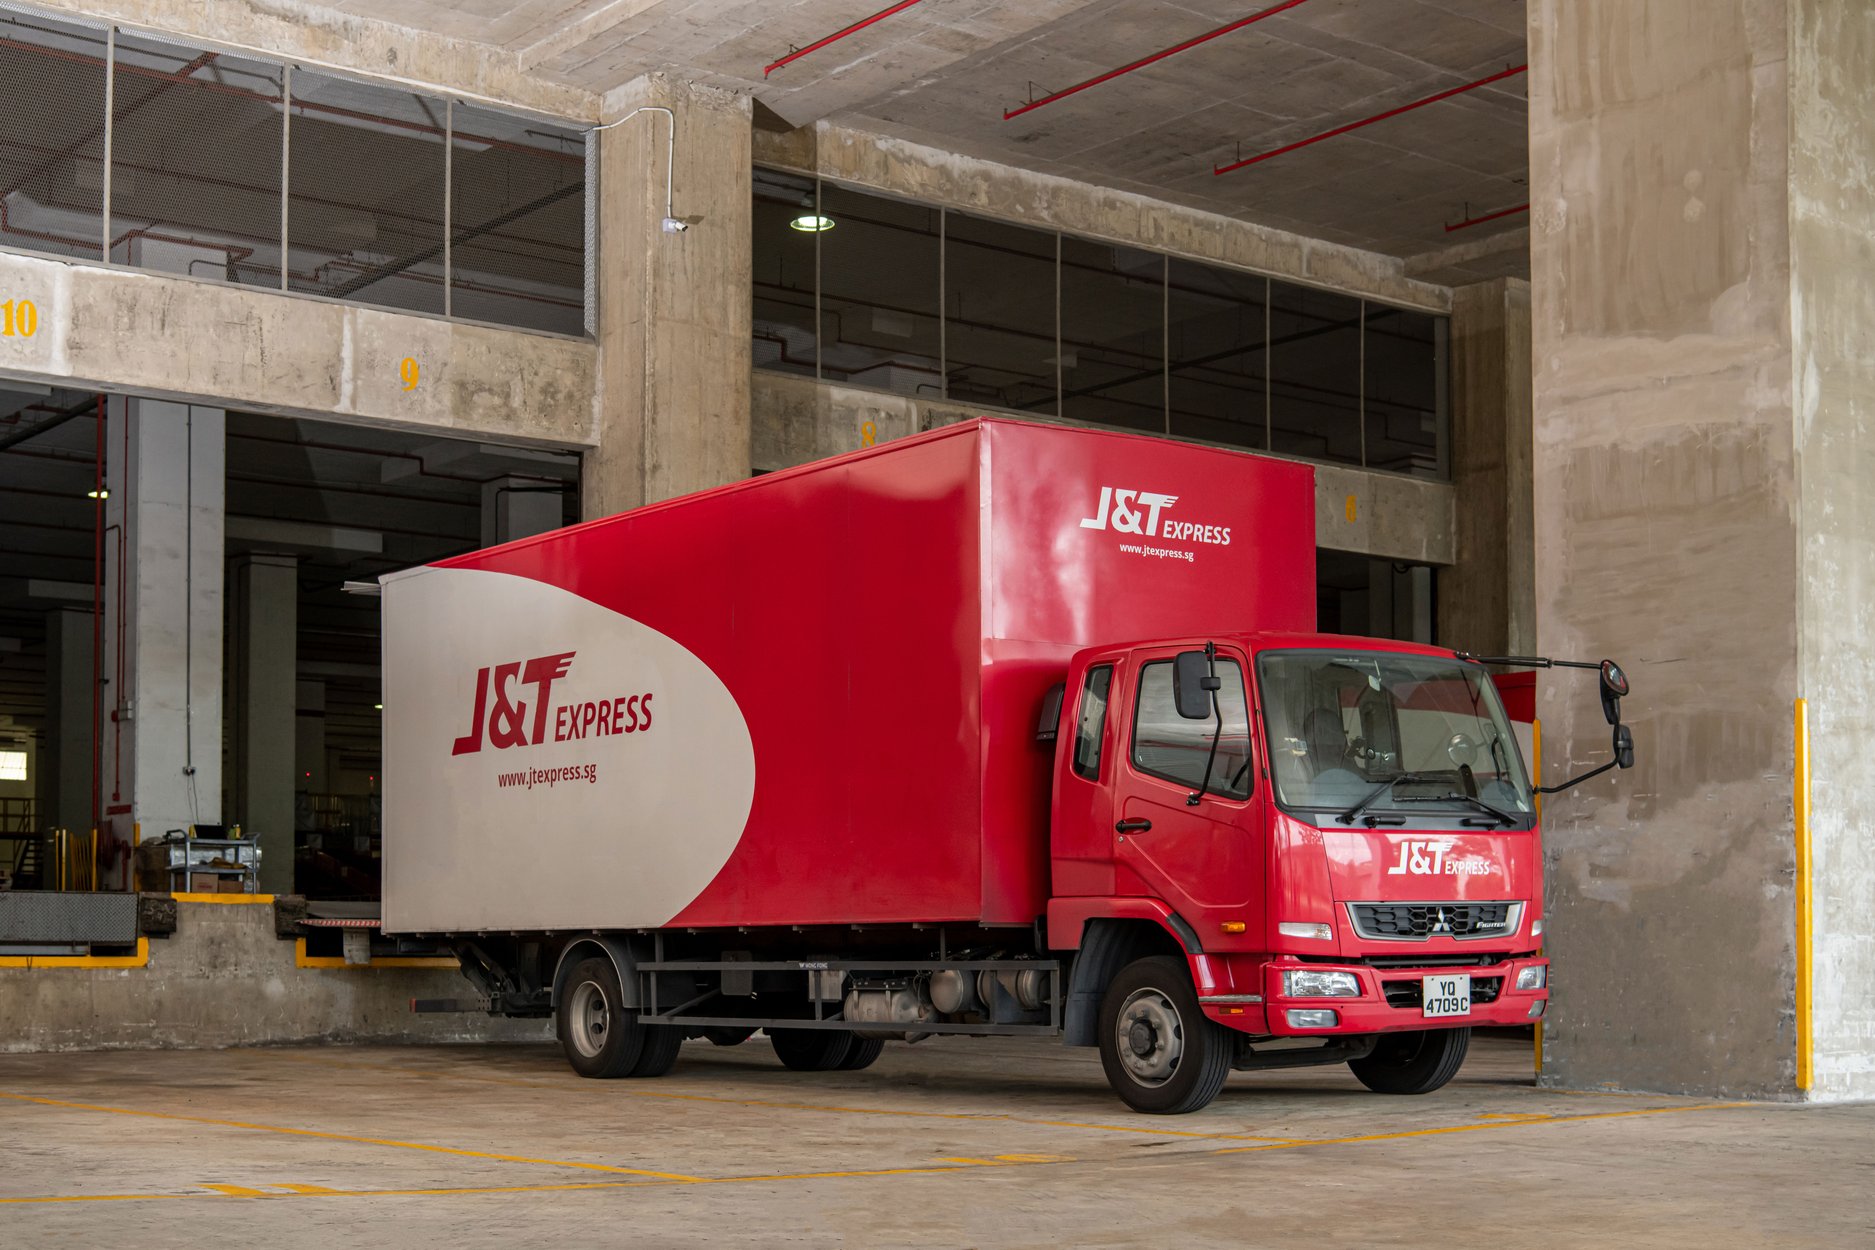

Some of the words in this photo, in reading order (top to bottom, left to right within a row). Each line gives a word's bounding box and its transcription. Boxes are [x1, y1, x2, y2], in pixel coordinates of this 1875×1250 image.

[0, 298, 37, 337] 10
[401, 357, 419, 392] 9
[861, 421, 876, 448] 8
[1080, 486, 1179, 537] J&T
[1163, 520, 1231, 546] EXPRESS
[1119, 543, 1194, 563] www.jtexpress.sg
[452, 651, 577, 756] J&T
[554, 693, 653, 742] EXPRESS
[498, 763, 597, 790] www.jtexpress.sg
[1387, 841, 1454, 875] J&T
[1445, 861, 1490, 875] EXPRESS
[1440, 981, 1455, 996] YQ
[1426, 997, 1468, 1013] 4709C
